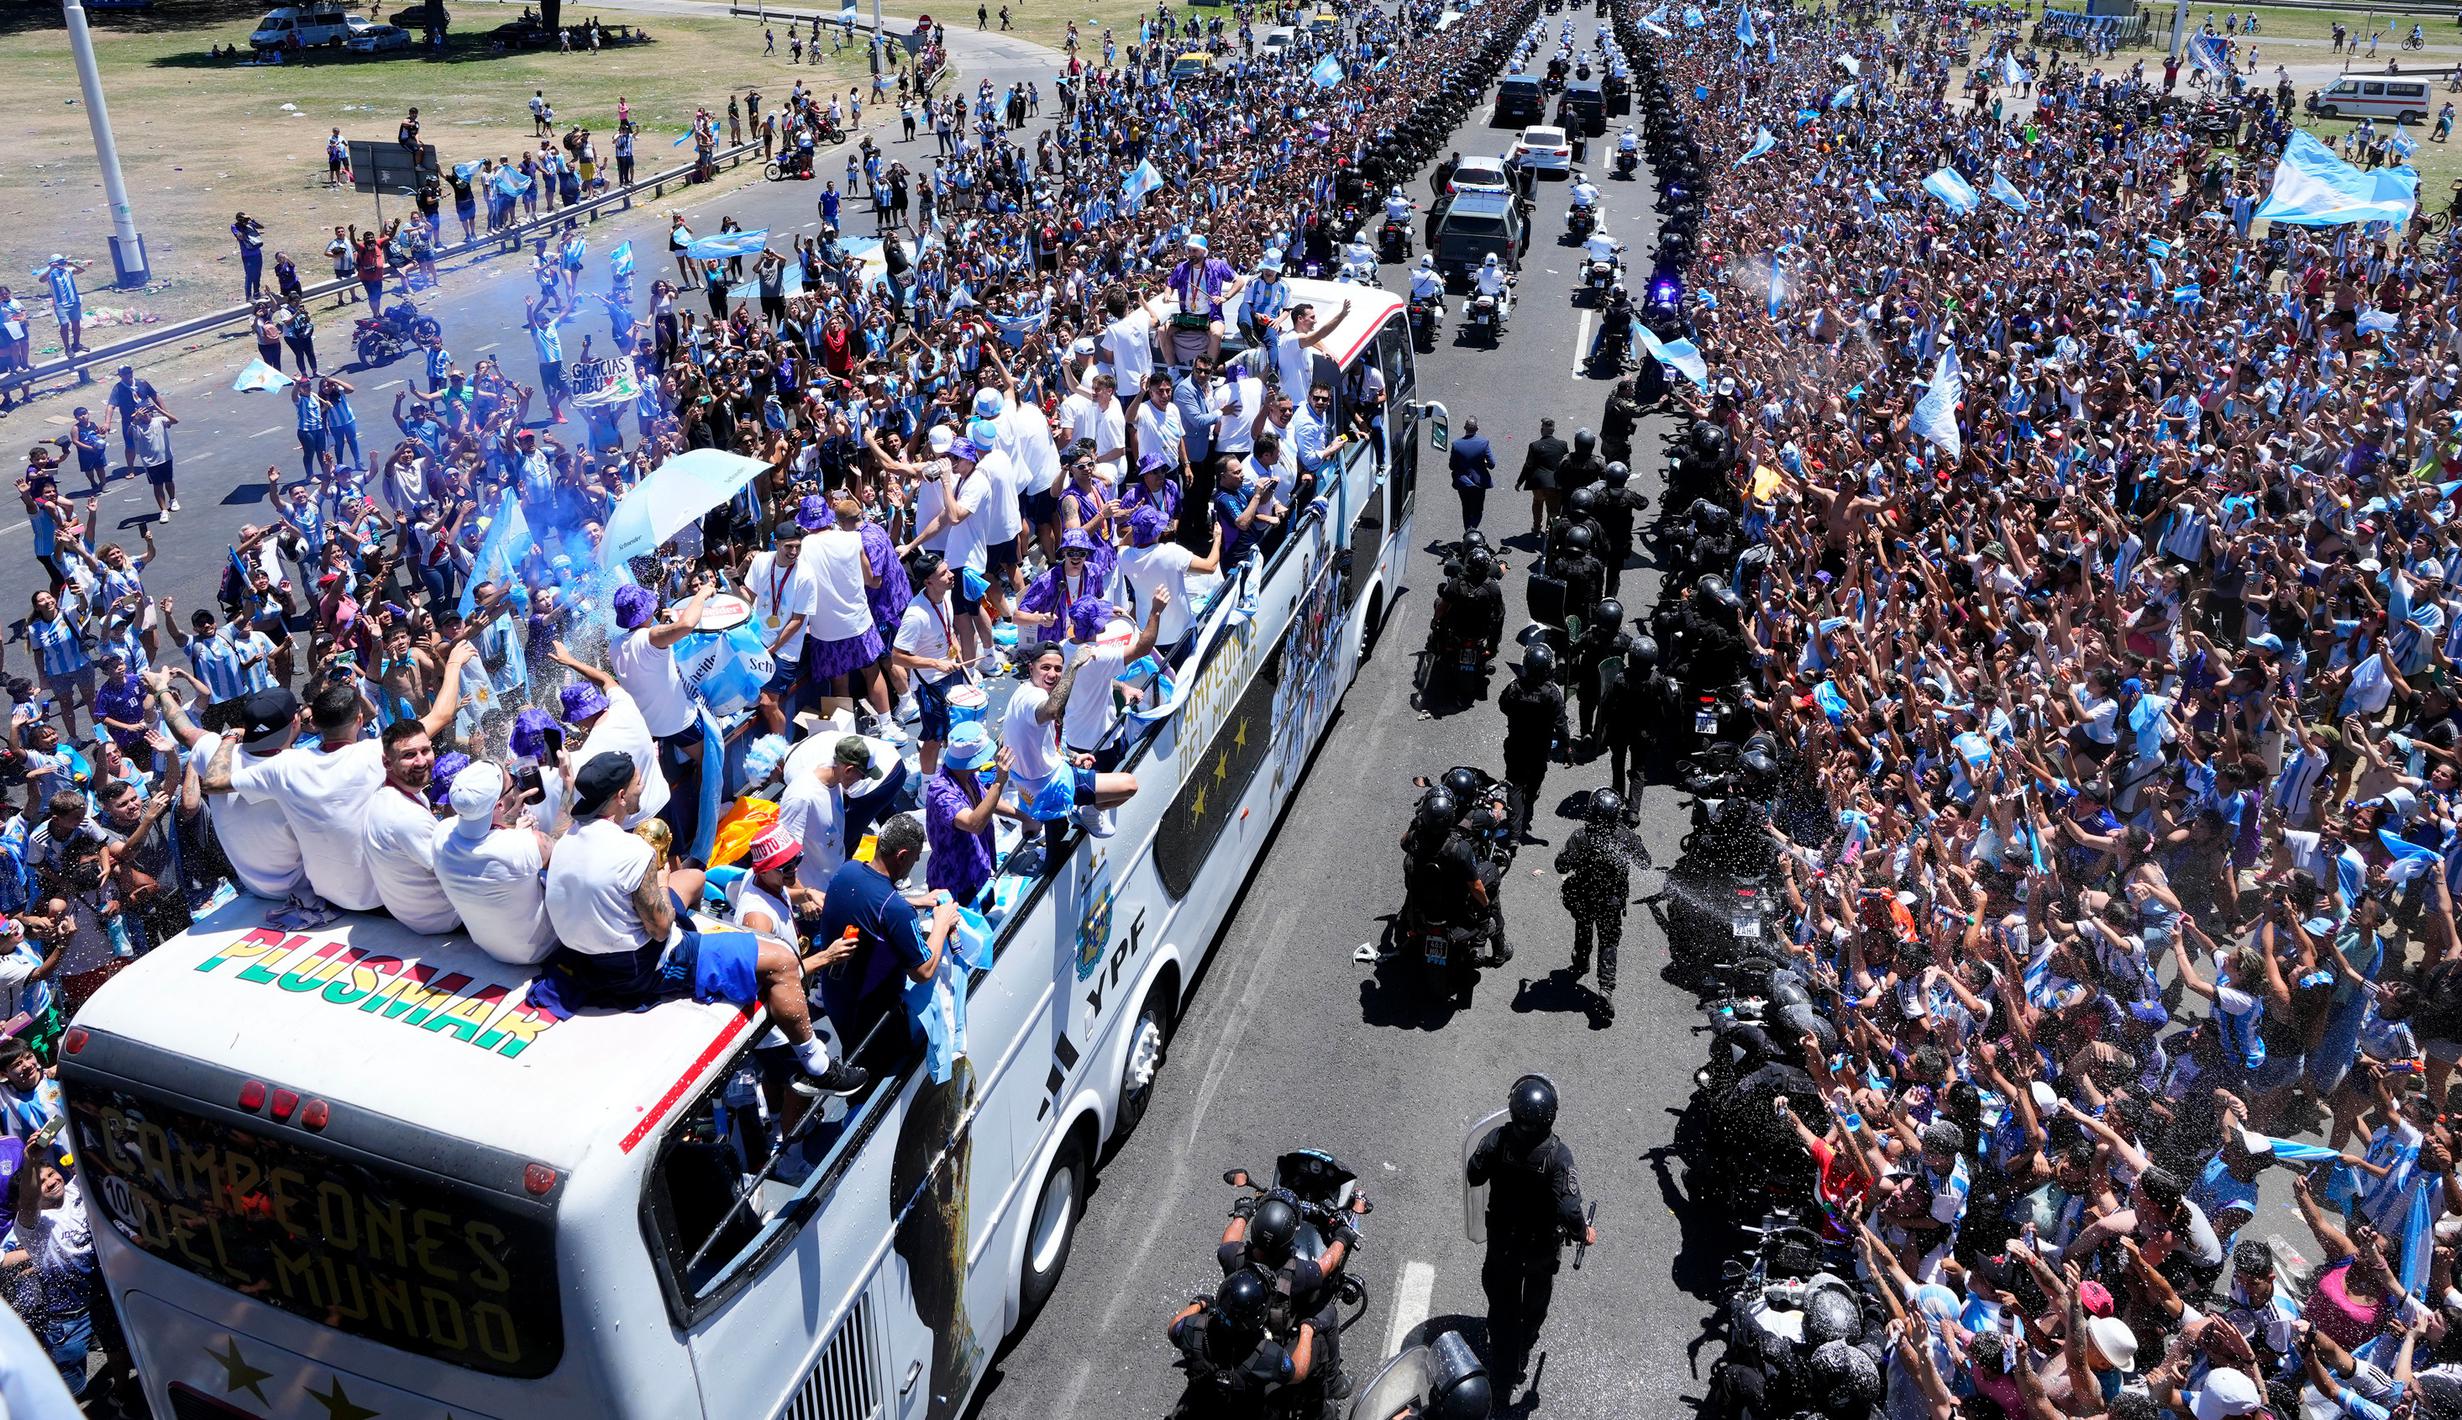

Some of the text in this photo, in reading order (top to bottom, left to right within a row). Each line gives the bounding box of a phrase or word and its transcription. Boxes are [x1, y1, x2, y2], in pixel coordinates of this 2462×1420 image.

[573, 358, 627, 378] GRACIAS
[573, 377, 603, 395] DIBU
[128, 696, 139, 708] 10
[749, 657, 774, 674] Sch
[1179, 643, 1256, 785] DEL MUNDO
[193, 926, 560, 1059] PLUSMAR
[1087, 905, 1146, 1019] YPF
[101, 1105, 512, 1292] CAMPEONES
[133, 1186, 522, 1364] DEL MUNDO
